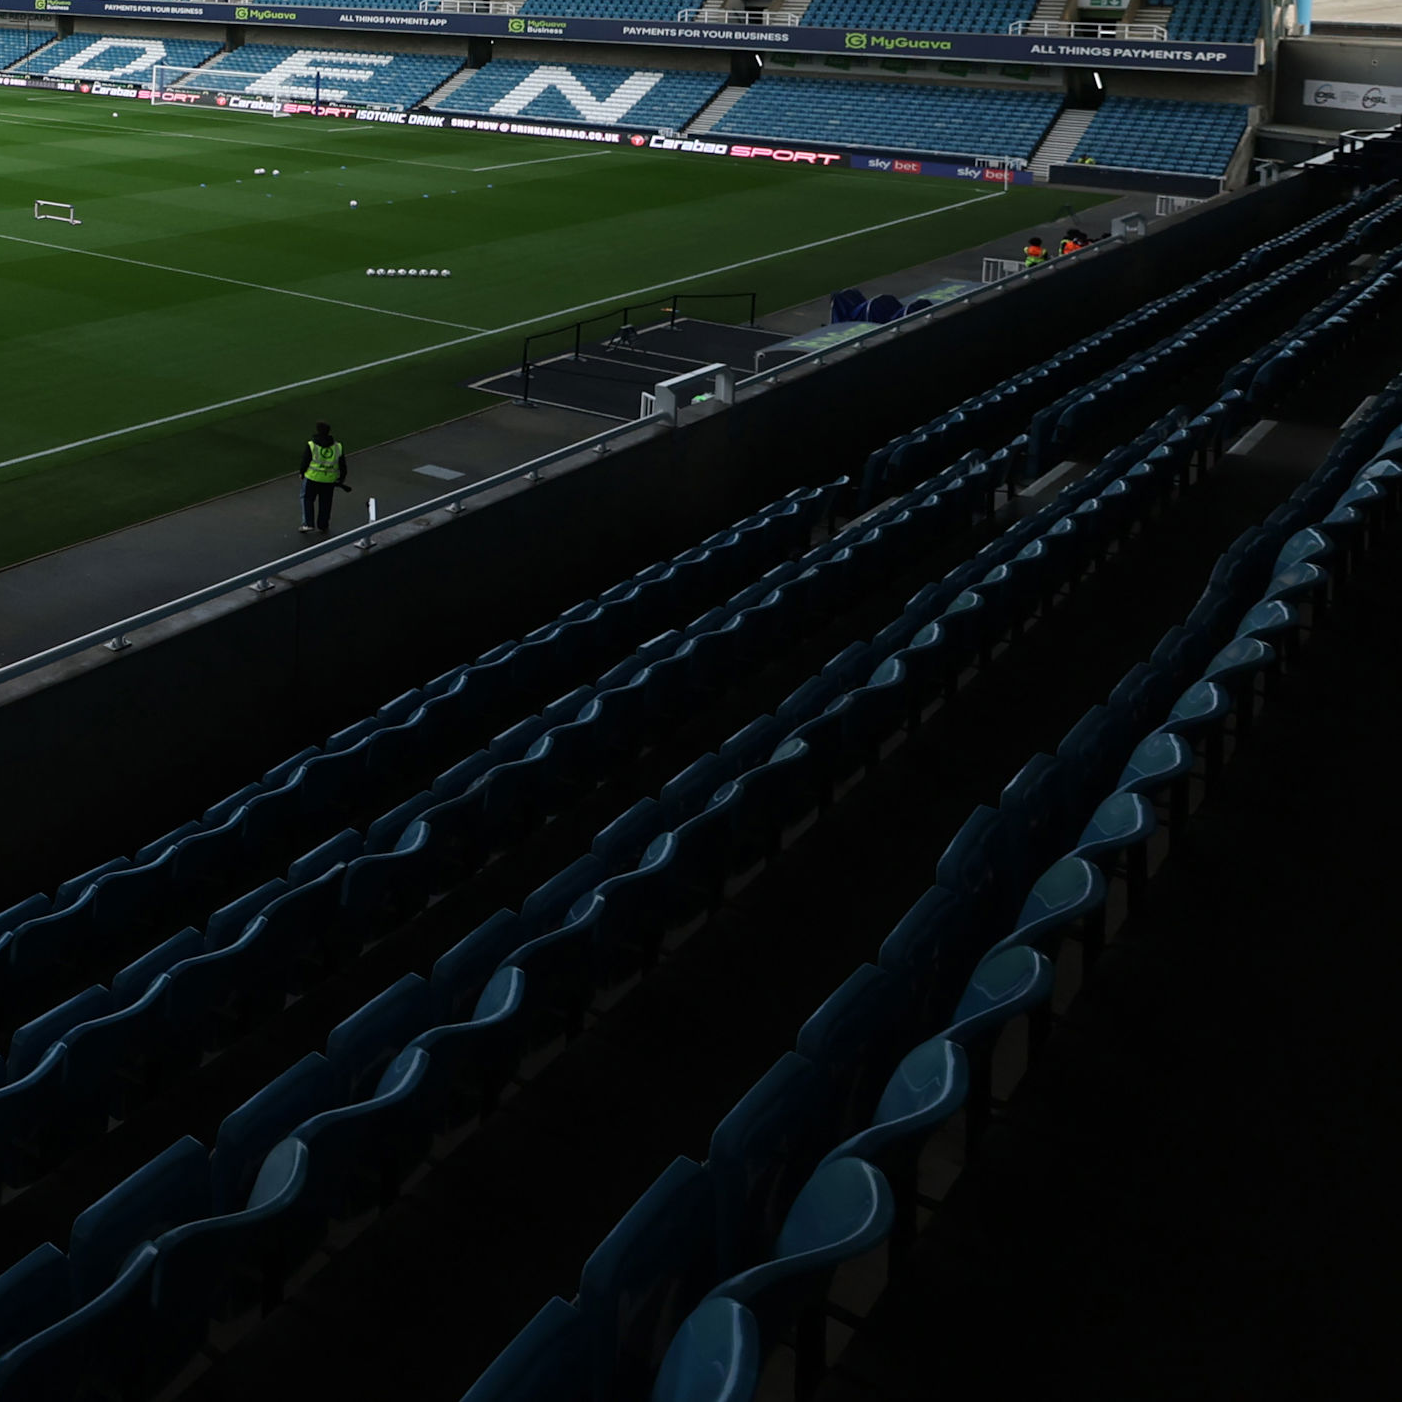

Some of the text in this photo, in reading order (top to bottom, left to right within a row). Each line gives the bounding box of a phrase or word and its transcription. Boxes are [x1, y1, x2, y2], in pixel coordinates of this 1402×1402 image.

[104, 4, 137, 12] PAYMENTS
[138, 5, 151, 13] FOR
[171, 7, 203, 15] BUSINESS
[250, 9, 296, 20] MyGuava
[339, 14, 447, 27] ALL THINGS PAYMENTS APP
[527, 20, 567, 29] MyGuava
[527, 26, 564, 34] Business
[623, 26, 789, 42] PAYMENTS FOR YOUR BUSINESS
[870, 35, 952, 50] MyGuava
[1030, 44, 1227, 63] ALL THINGS PAYMENTS APP
[47, 35, 665, 128] DEN
[92, 84, 138, 98] Carabao
[228, 97, 445, 127] Carabao SPORT ISOTONIC DRINK
[450, 118, 620, 143] SHOP NOW @ DRINKCARABAO.CO.UK
[648, 135, 842, 166] Carabao SPORT
[868, 158, 920, 173] sky bet
[957, 166, 1010, 182] sky bet
